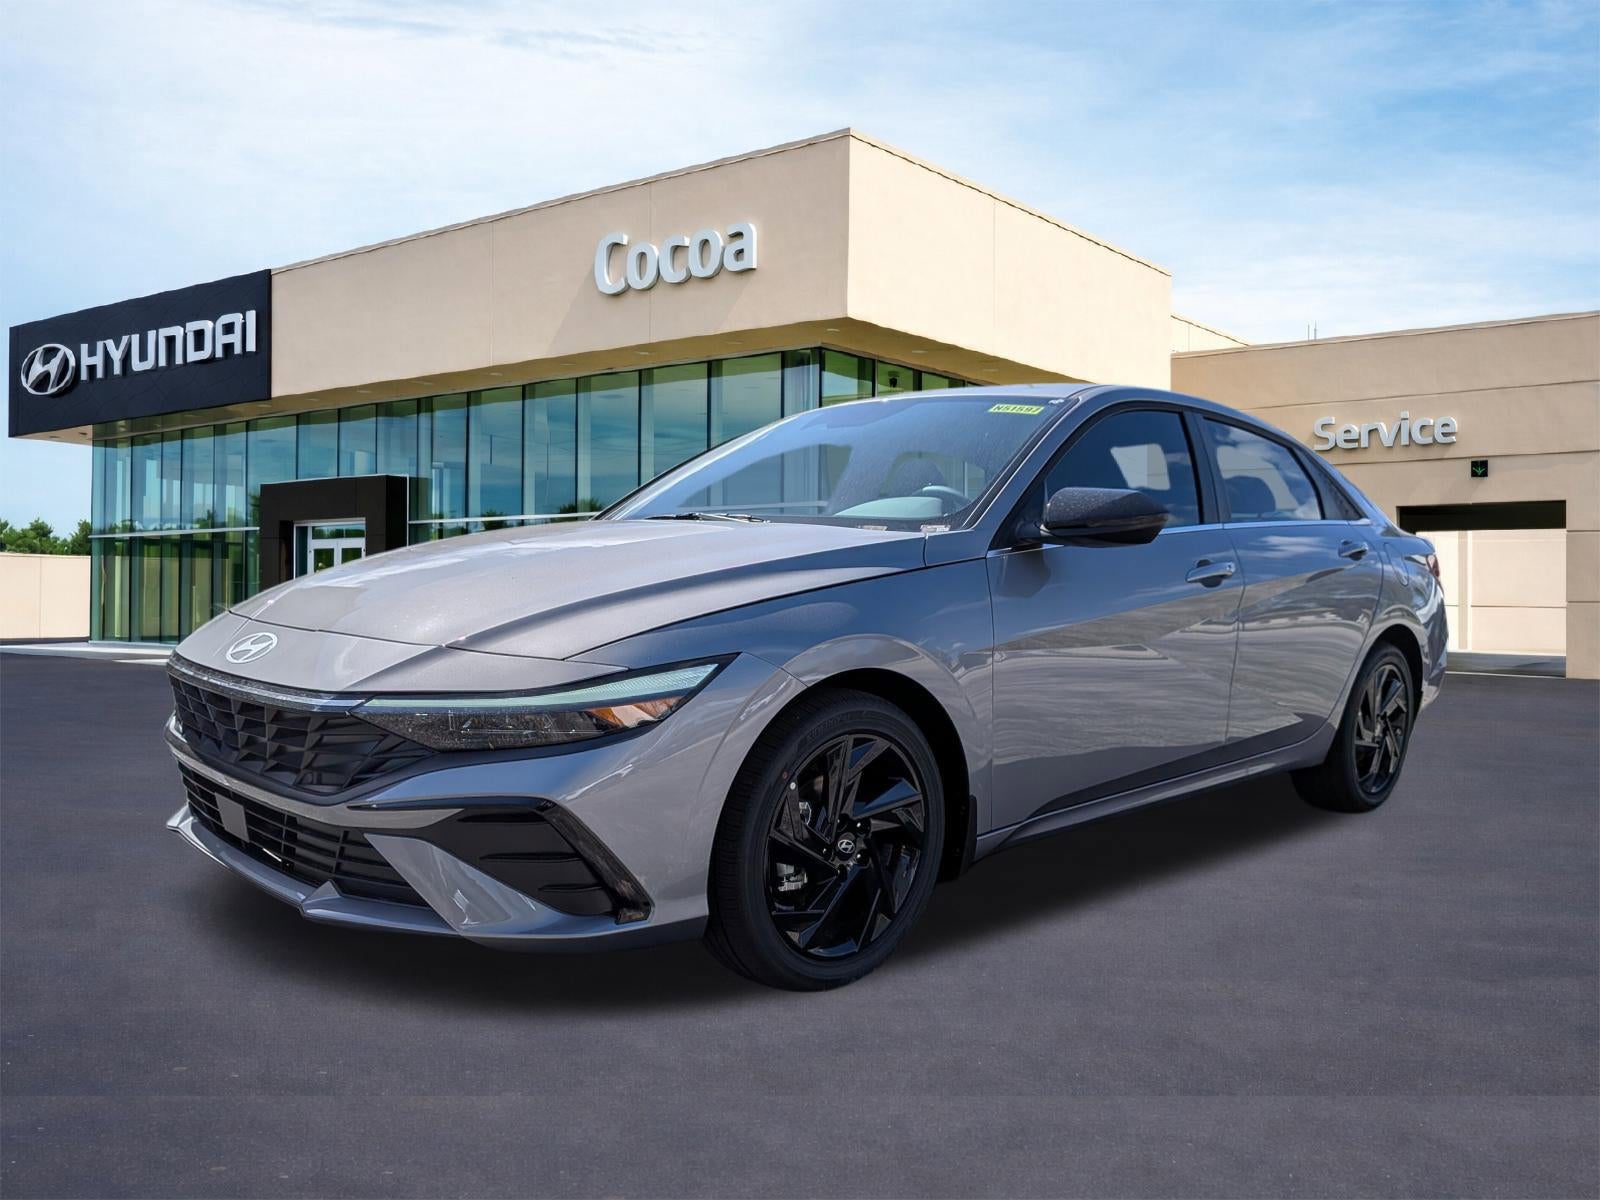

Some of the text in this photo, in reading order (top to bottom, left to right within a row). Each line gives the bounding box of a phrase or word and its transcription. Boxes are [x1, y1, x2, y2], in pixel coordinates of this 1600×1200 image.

[594, 222, 758, 296] Cocoa
[80, 309, 257, 382] HYUNDAI
[1312, 410, 1458, 451] Service
